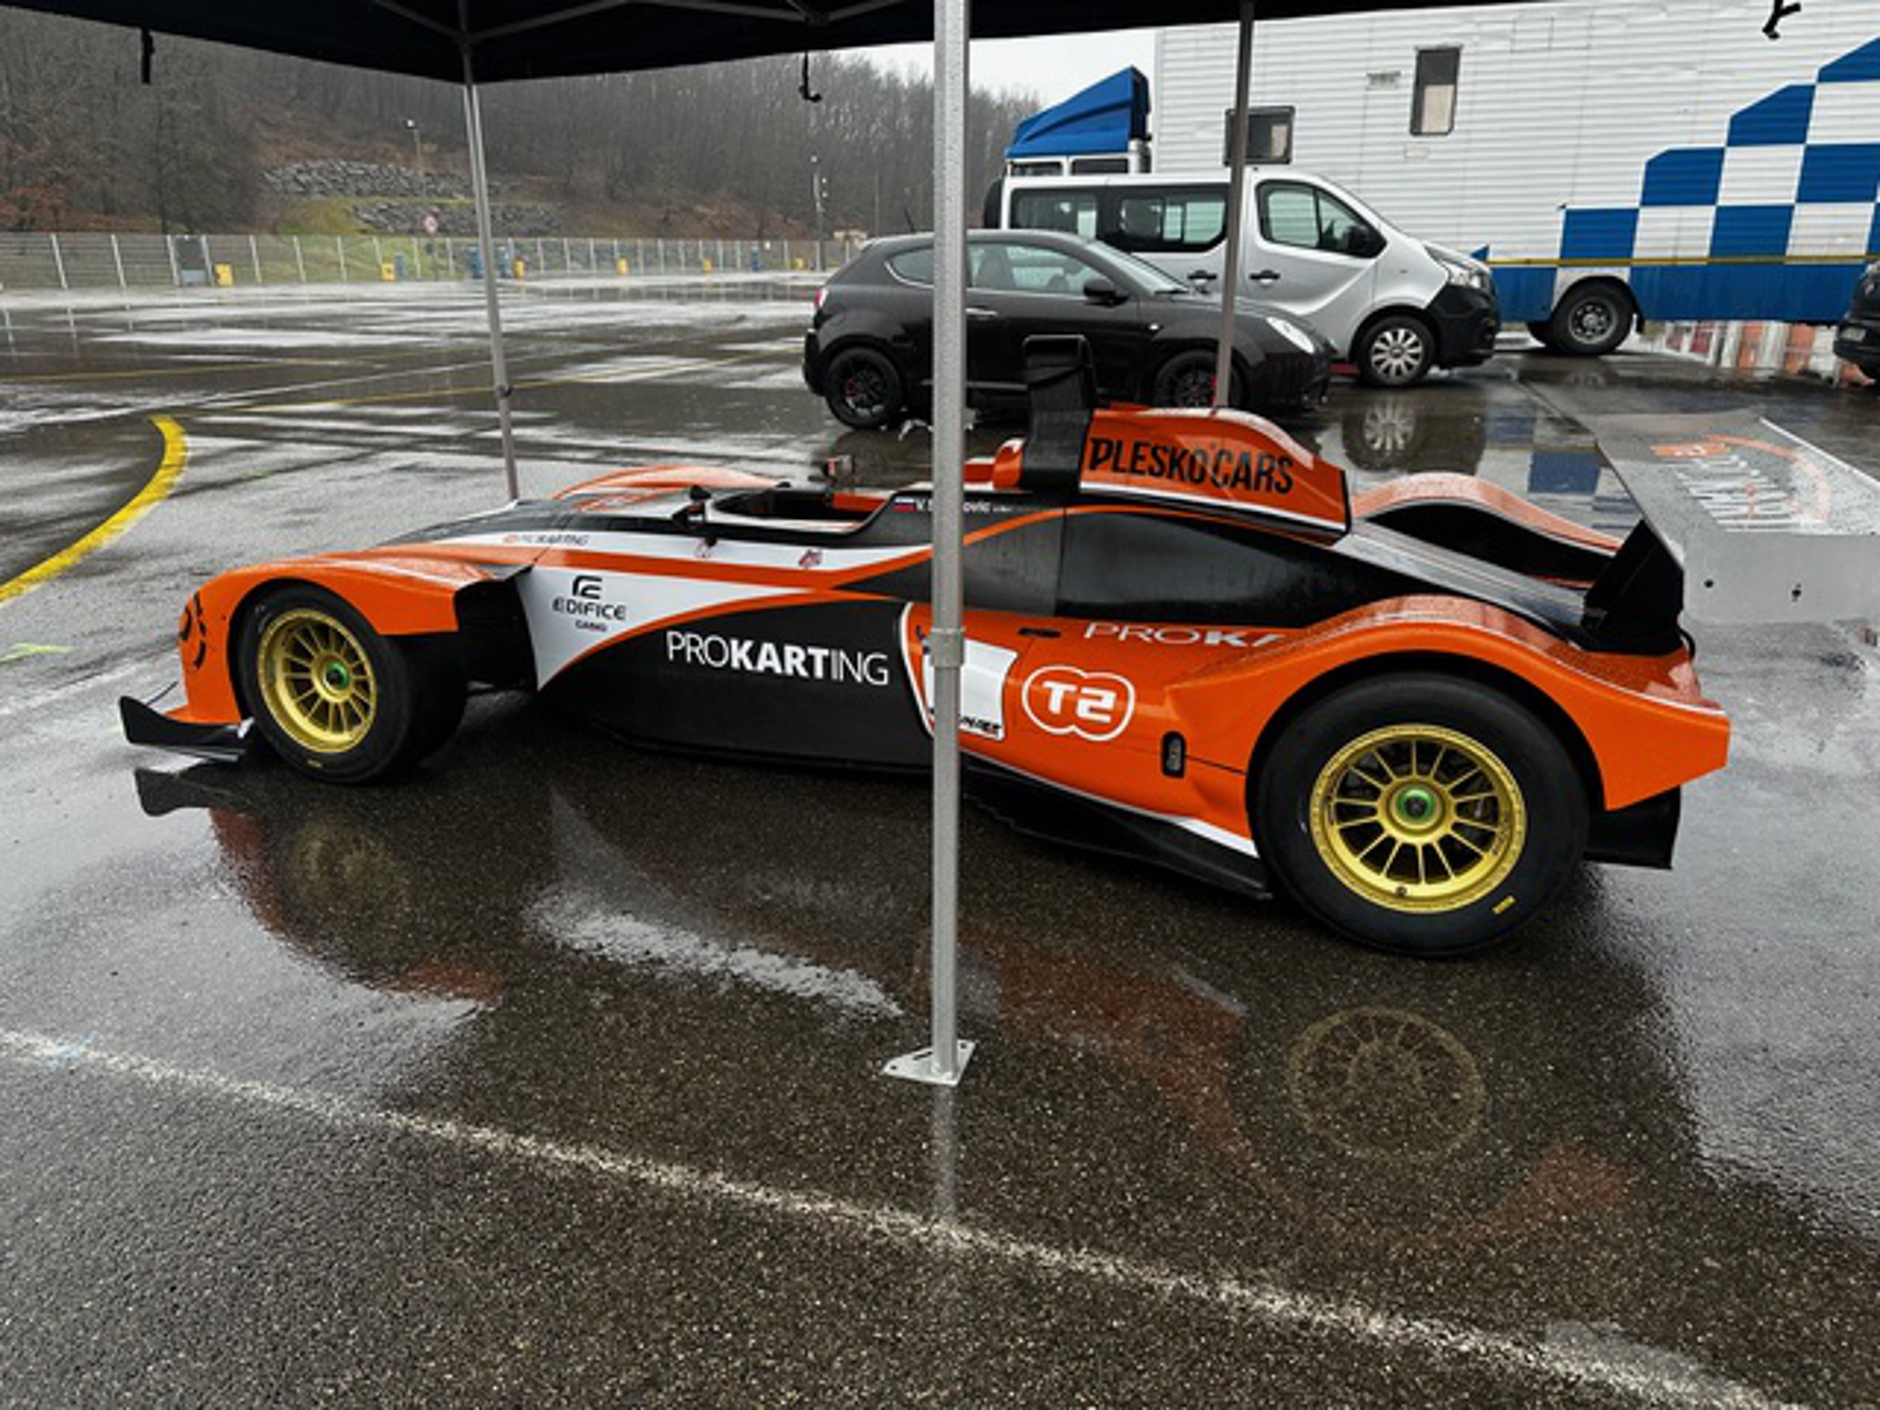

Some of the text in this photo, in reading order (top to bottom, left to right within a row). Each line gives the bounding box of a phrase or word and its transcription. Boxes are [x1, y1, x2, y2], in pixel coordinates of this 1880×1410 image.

[551, 596, 627, 621] EDIFICE
[666, 630, 889, 686] PROKARTING
[1041, 680, 1118, 724] T2
